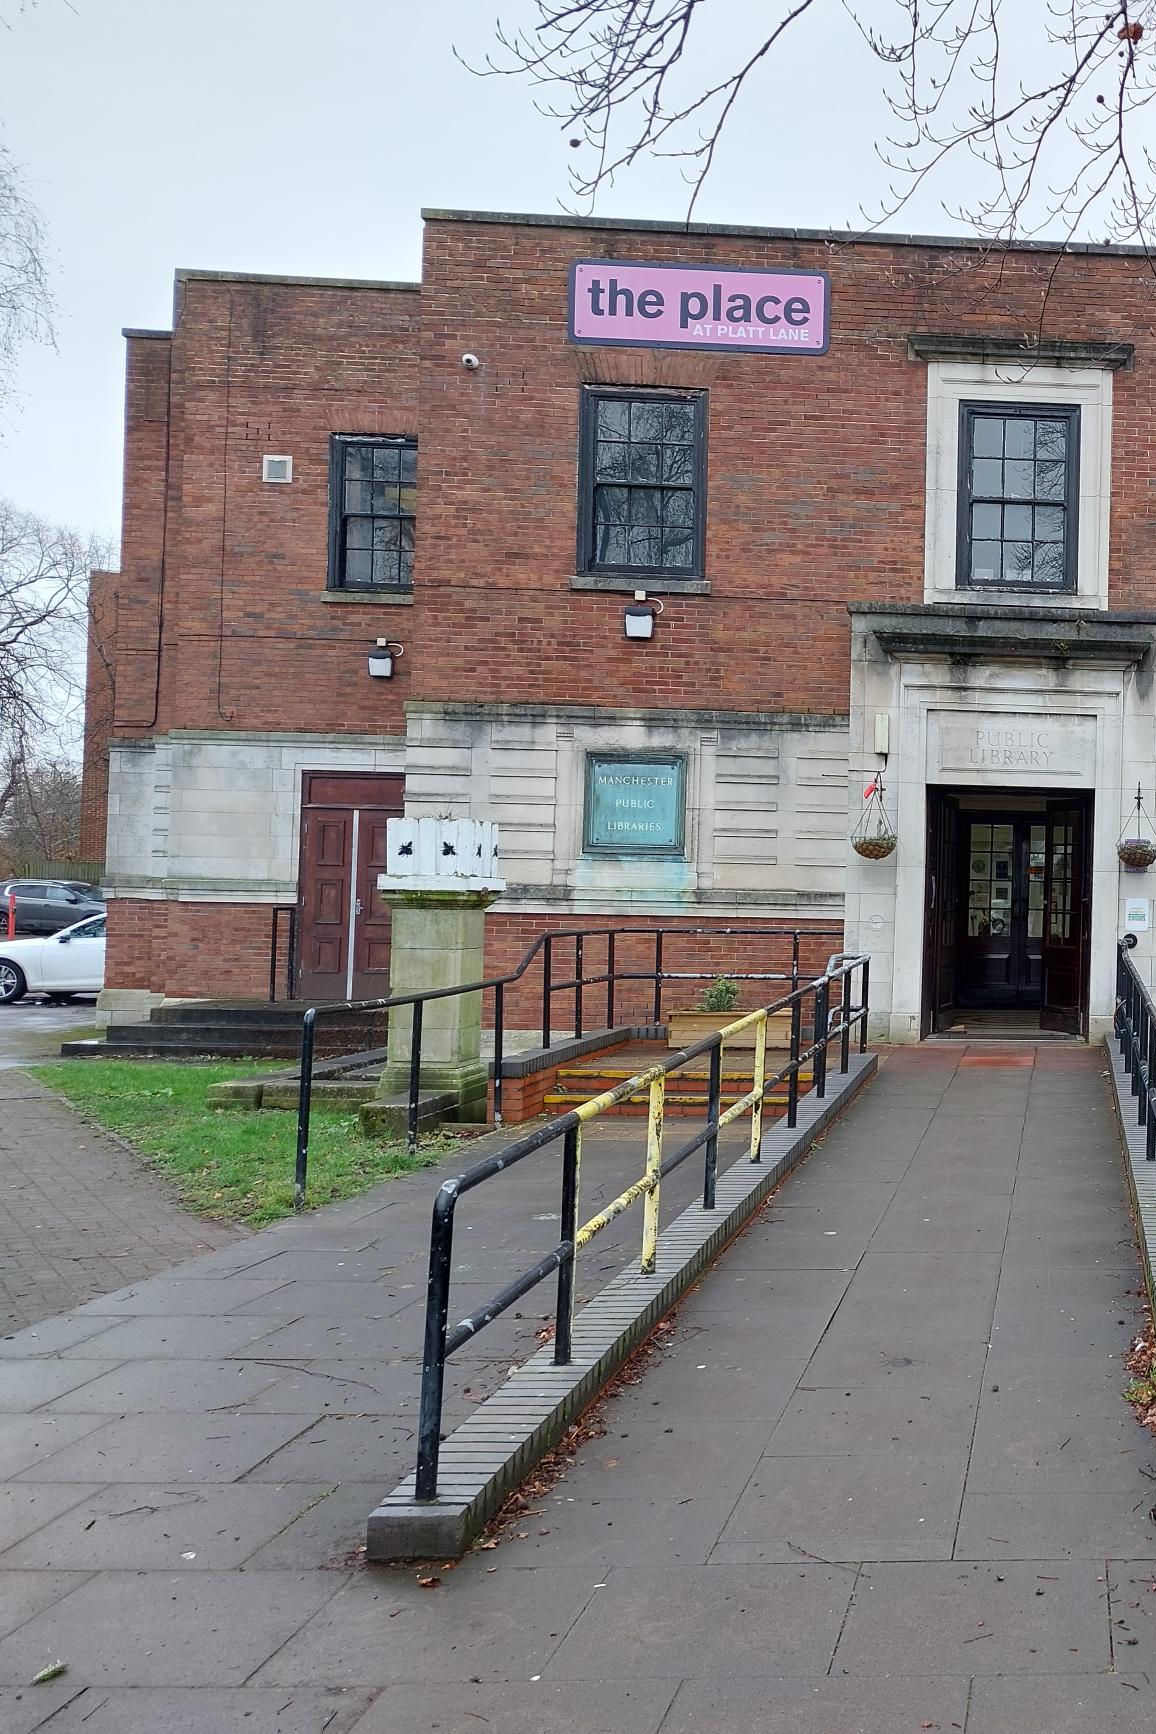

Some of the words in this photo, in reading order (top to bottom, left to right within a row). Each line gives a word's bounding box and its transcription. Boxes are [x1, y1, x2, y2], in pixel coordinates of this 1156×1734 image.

[587, 278, 665, 319] the
[679, 283, 811, 329] place
[692, 324, 712, 337] AT
[717, 325, 766, 340] PLATT
[769, 327, 810, 341] LANE
[975, 730, 1049, 748] PUBLIC
[969, 749, 1053, 766] LIBRARY
[598, 775, 673, 786] MANCHESTER
[615, 798, 655, 809] PUBLIC
[607, 821, 661, 831] LIBRARIES
